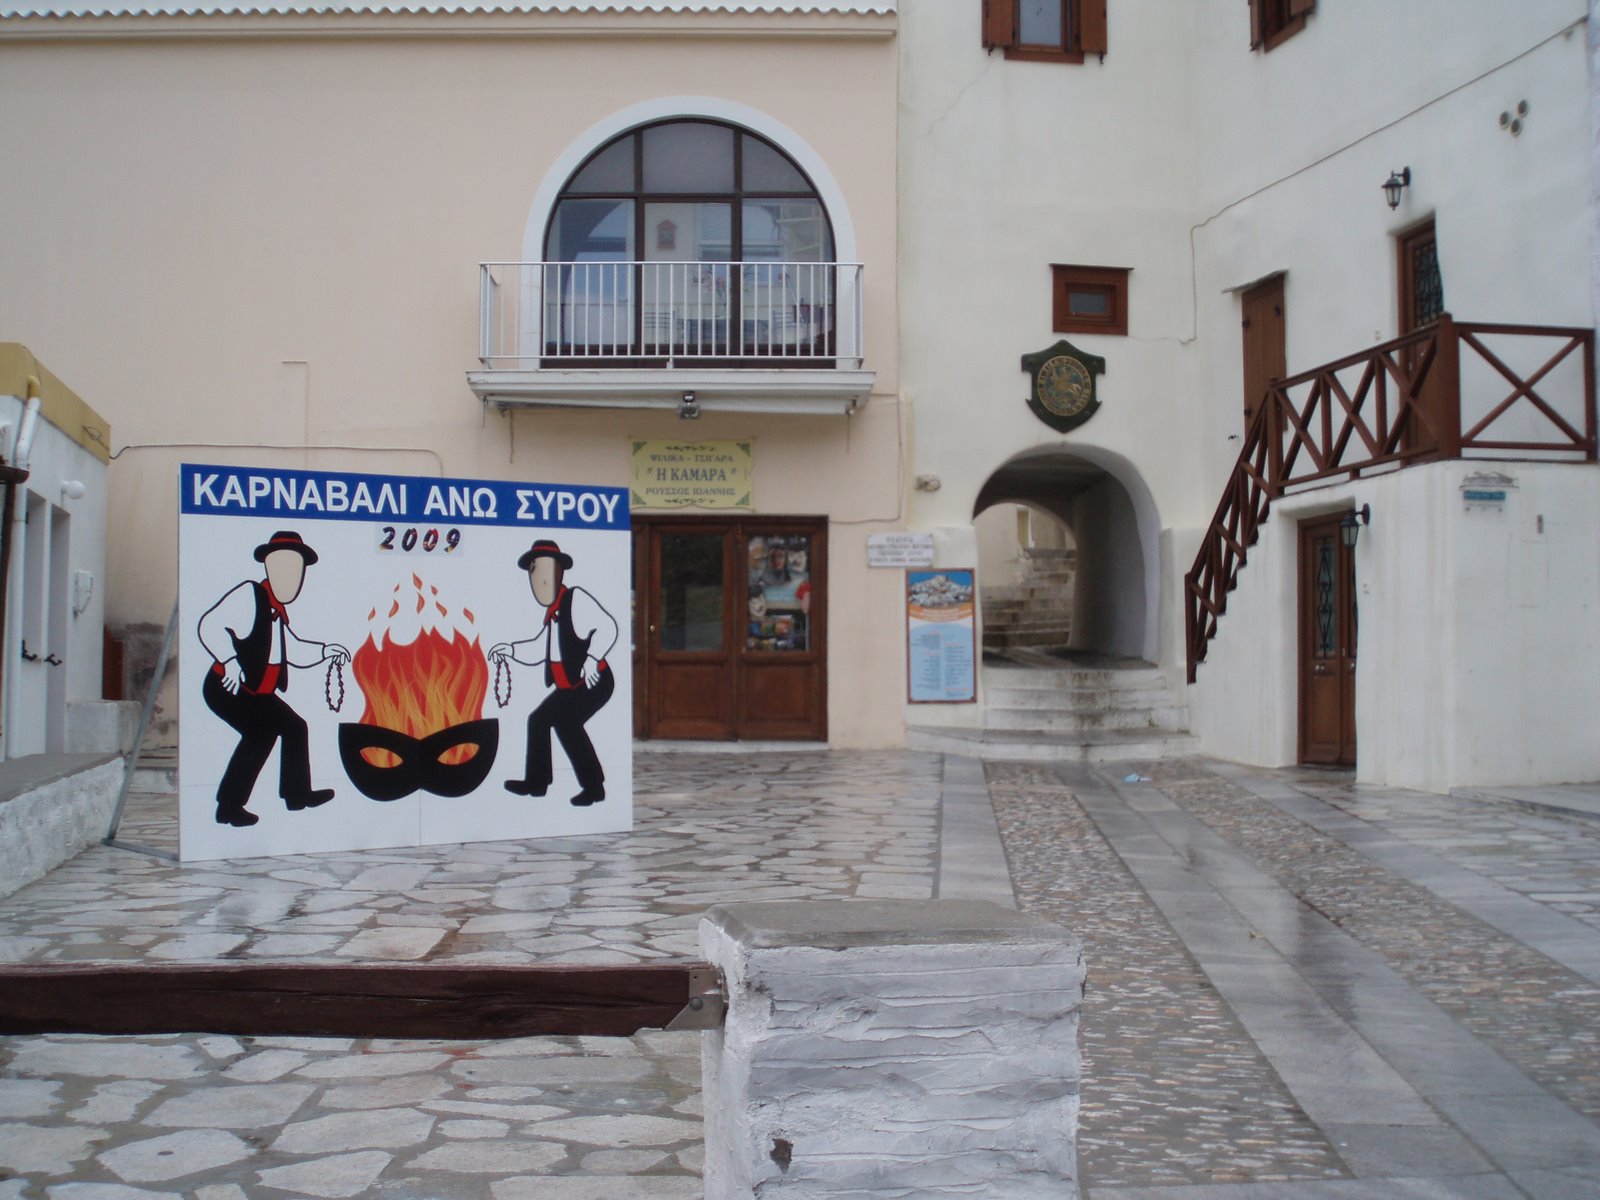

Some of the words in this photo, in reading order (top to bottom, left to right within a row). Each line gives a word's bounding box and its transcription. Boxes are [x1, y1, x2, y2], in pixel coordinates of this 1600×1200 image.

[696, 454, 734, 462] ΤΣΙΓΑΡΑ
[193, 473, 407, 515] ΚΑΡΝΑΒΑΛΙ
[423, 485, 498, 519] ΑΝΩ
[516, 489, 620, 524] ΣΥΡΟΥ
[692, 487, 735, 496] ΙΩΑΝΝΗΣ
[379, 526, 461, 553] 2009
